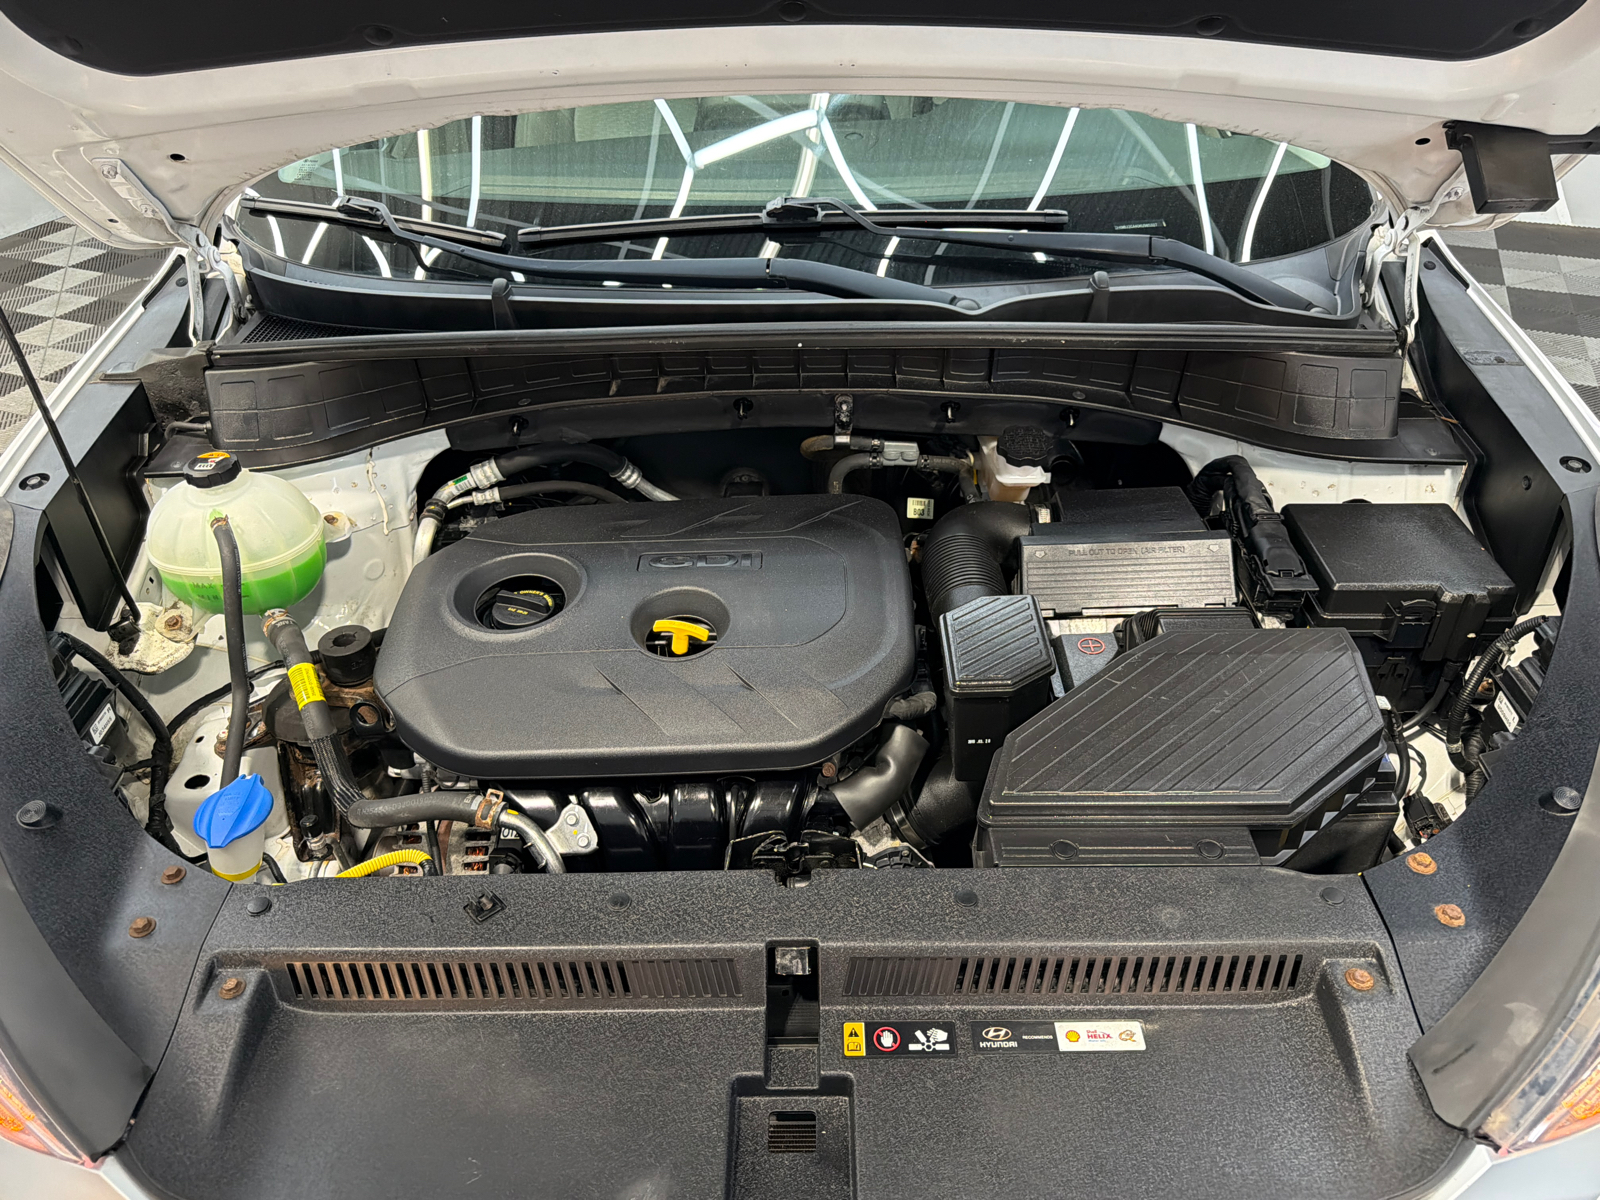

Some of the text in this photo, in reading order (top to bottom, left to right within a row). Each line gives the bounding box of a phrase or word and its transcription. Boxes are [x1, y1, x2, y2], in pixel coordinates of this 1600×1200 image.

[1068, 549, 1087, 557] PULL
[1089, 548, 1104, 556] OUT
[1118, 547, 1138, 555] OPEN
[649, 554, 753, 568] GDI
